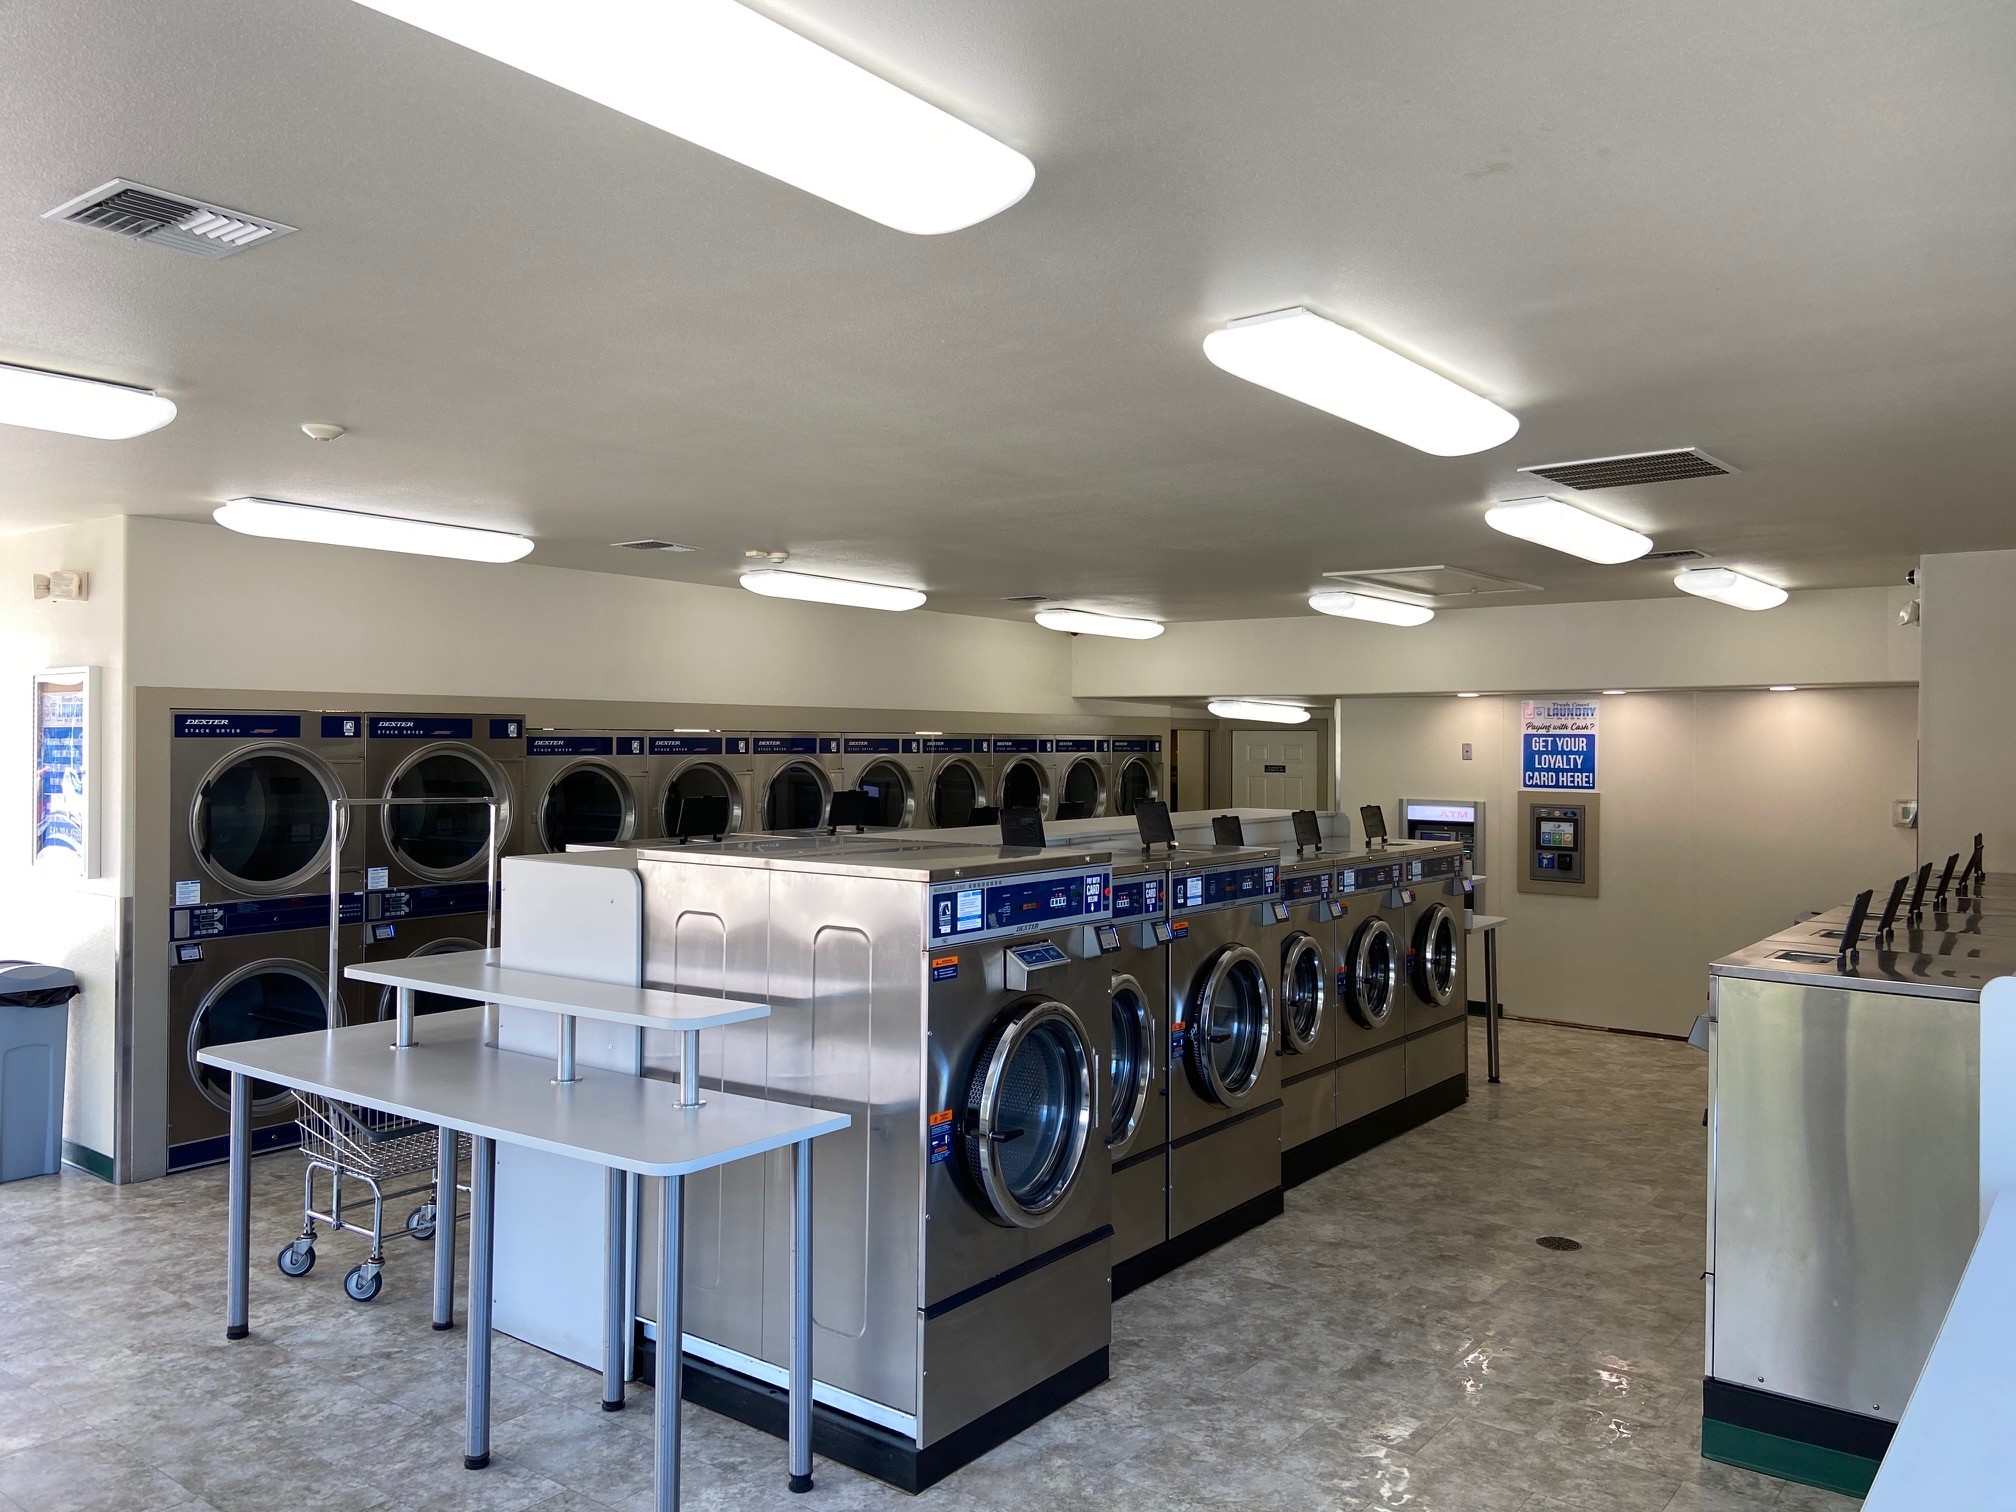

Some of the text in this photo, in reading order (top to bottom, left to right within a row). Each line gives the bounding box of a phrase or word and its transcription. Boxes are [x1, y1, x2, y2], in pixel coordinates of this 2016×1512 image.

[1547, 707, 1596, 717] LAUNDRY
[1525, 722, 1595, 733] Paying with Cash?
[1532, 737, 1587, 751] GET YOUR
[1534, 754, 1584, 769] LOYALTY
[1525, 771, 1594, 787] CARD HERE!
[1440, 810, 1468, 818] ATM
[1086, 884, 1100, 895] CARD
[1016, 923, 1040, 932] DEXTER
